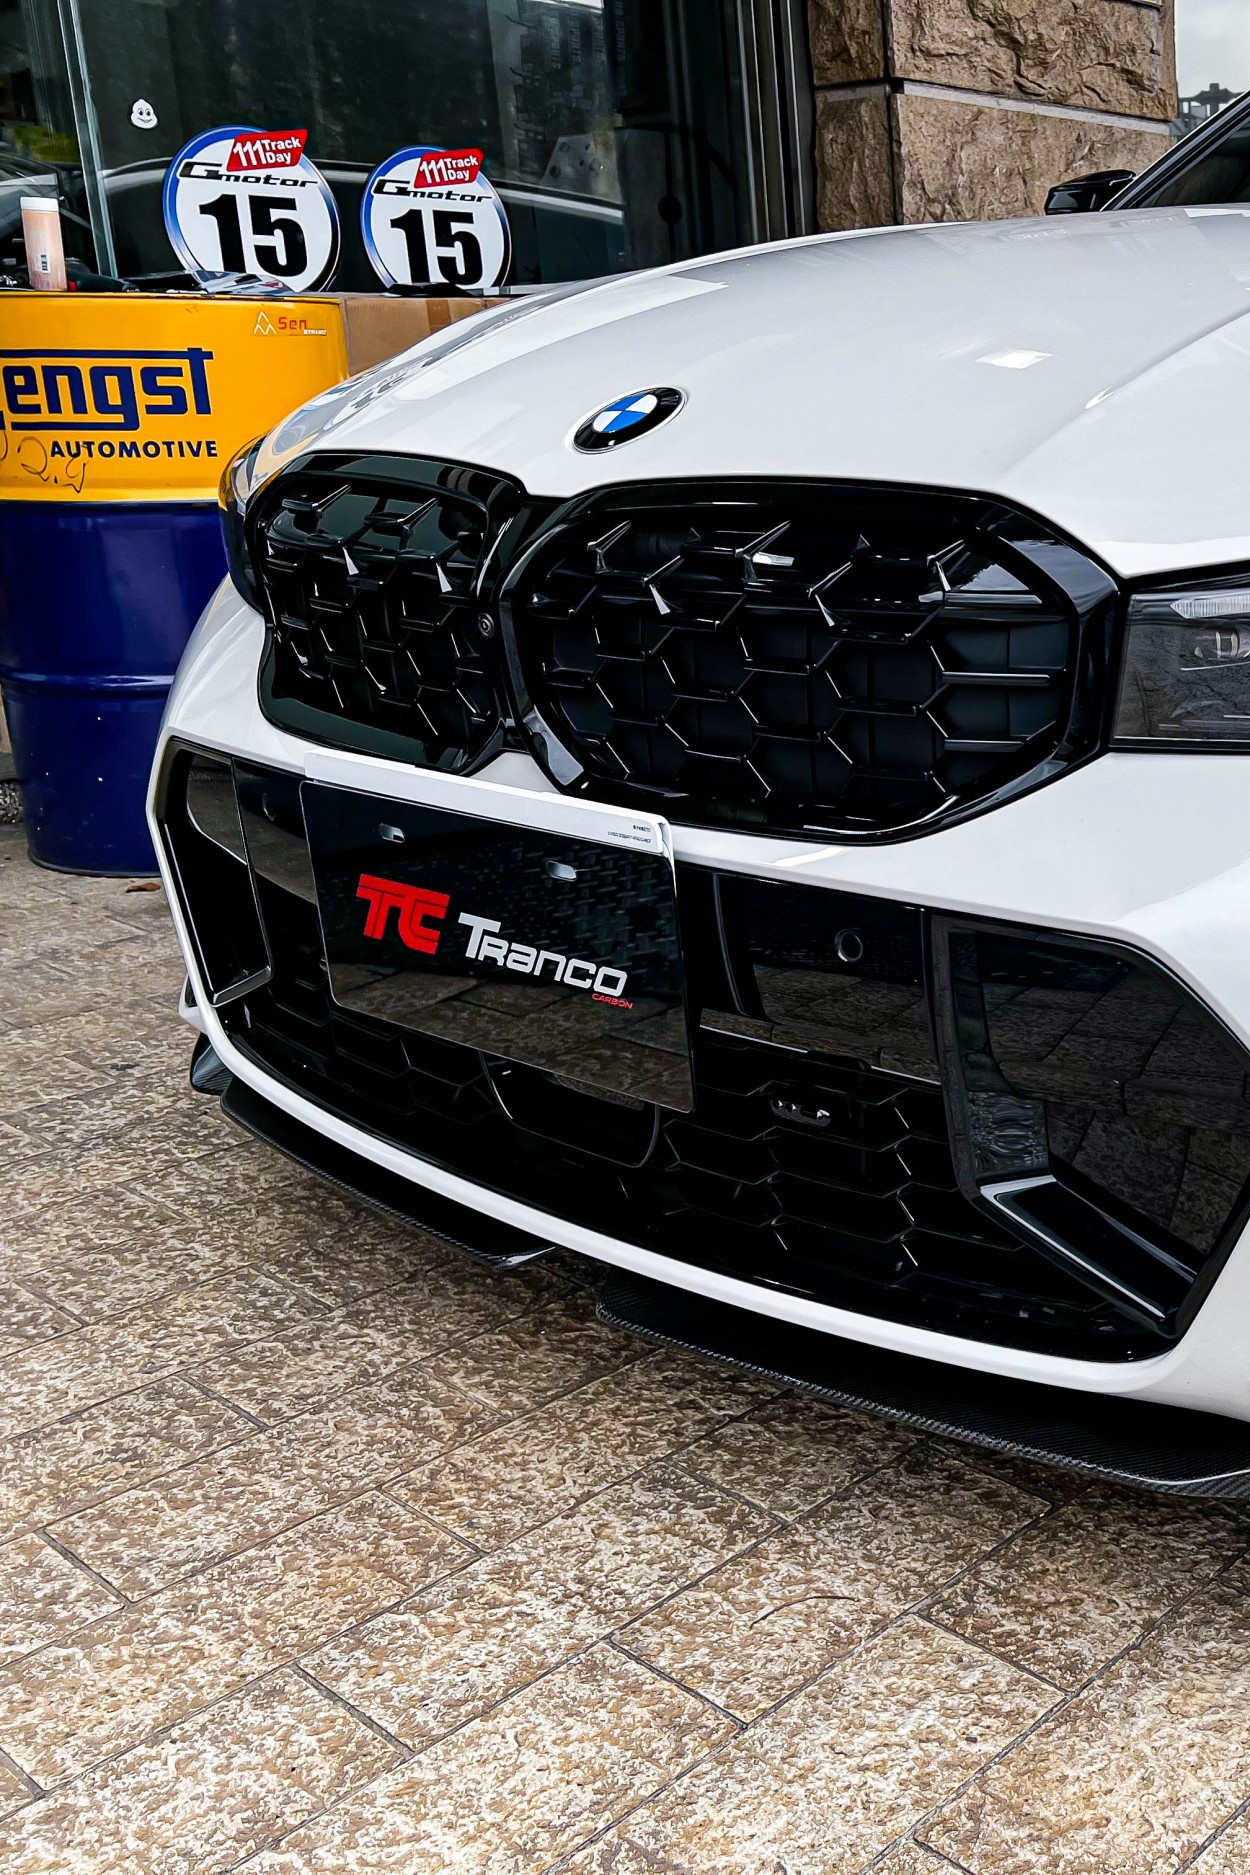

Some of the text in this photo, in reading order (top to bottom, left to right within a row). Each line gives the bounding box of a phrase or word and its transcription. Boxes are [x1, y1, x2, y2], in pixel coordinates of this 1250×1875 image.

[232, 136, 302, 167] 111 Track
[265, 152, 292, 167] Day
[179, 161, 318, 188] Gmotor
[419, 155, 479, 184] 111 Track
[449, 169, 470, 181] Day
[373, 178, 493, 203] Gmotor
[199, 193, 308, 277] 15
[389, 208, 484, 286] 15
[278, 316, 307, 330] Sen
[0, 347, 214, 431] engst
[50, 440, 218, 458] AUTOMOTIVE
[591, 993, 634, 1010] CARBON
